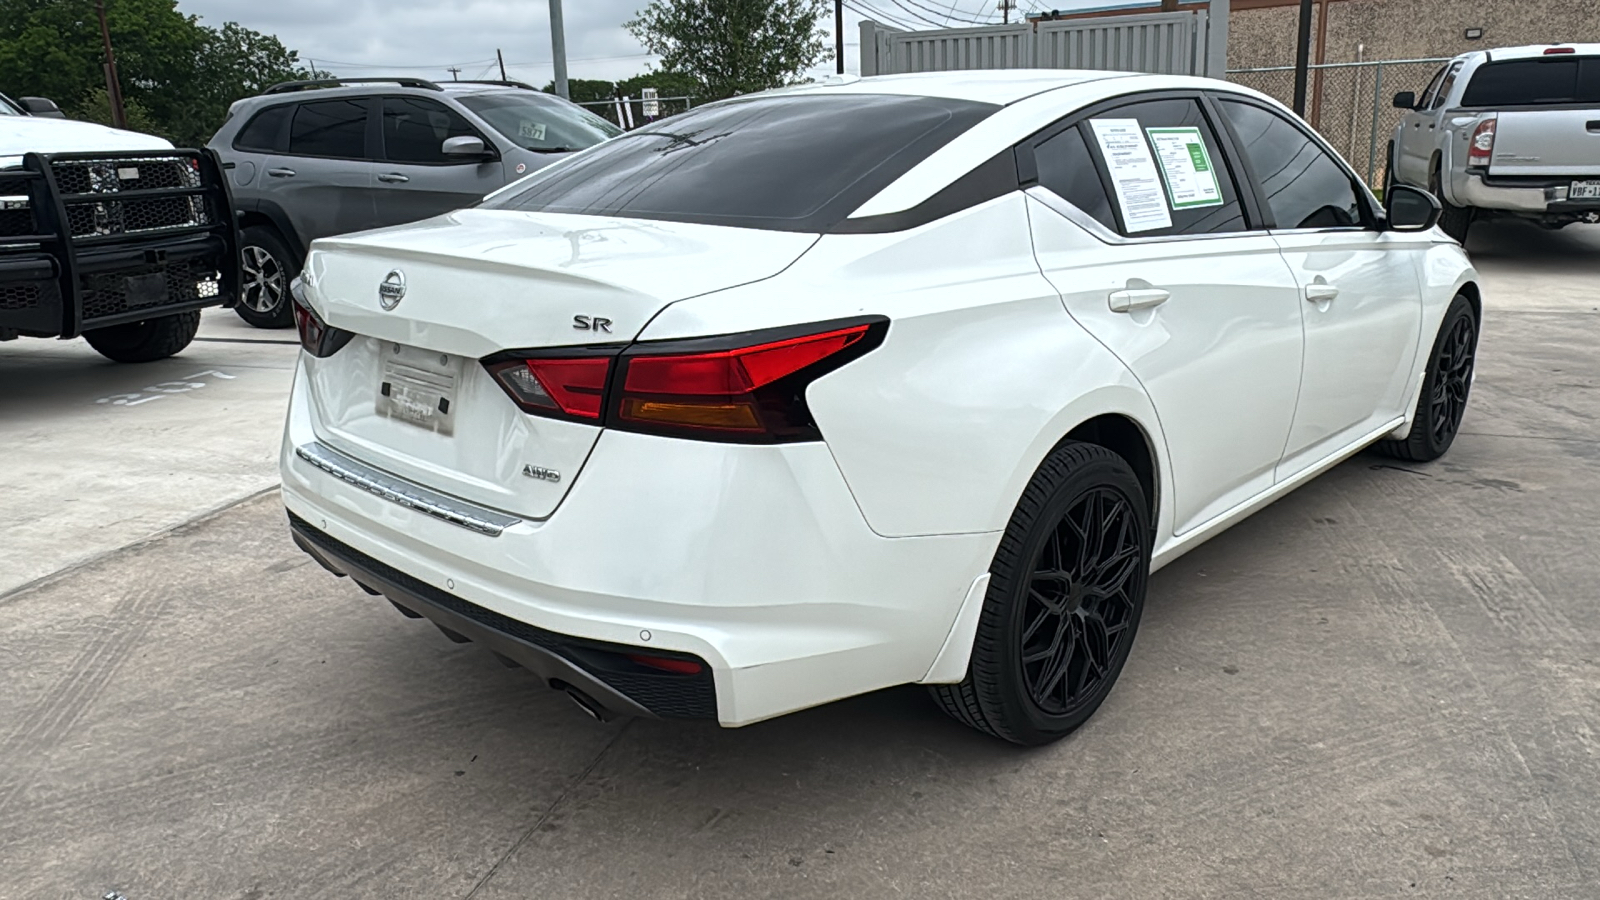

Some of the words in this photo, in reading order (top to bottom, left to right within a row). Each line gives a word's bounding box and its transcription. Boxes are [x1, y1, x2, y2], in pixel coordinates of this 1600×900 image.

[521, 126, 543, 139] 5877
[572, 314, 613, 334] SR
[522, 464, 561, 483] AWD
